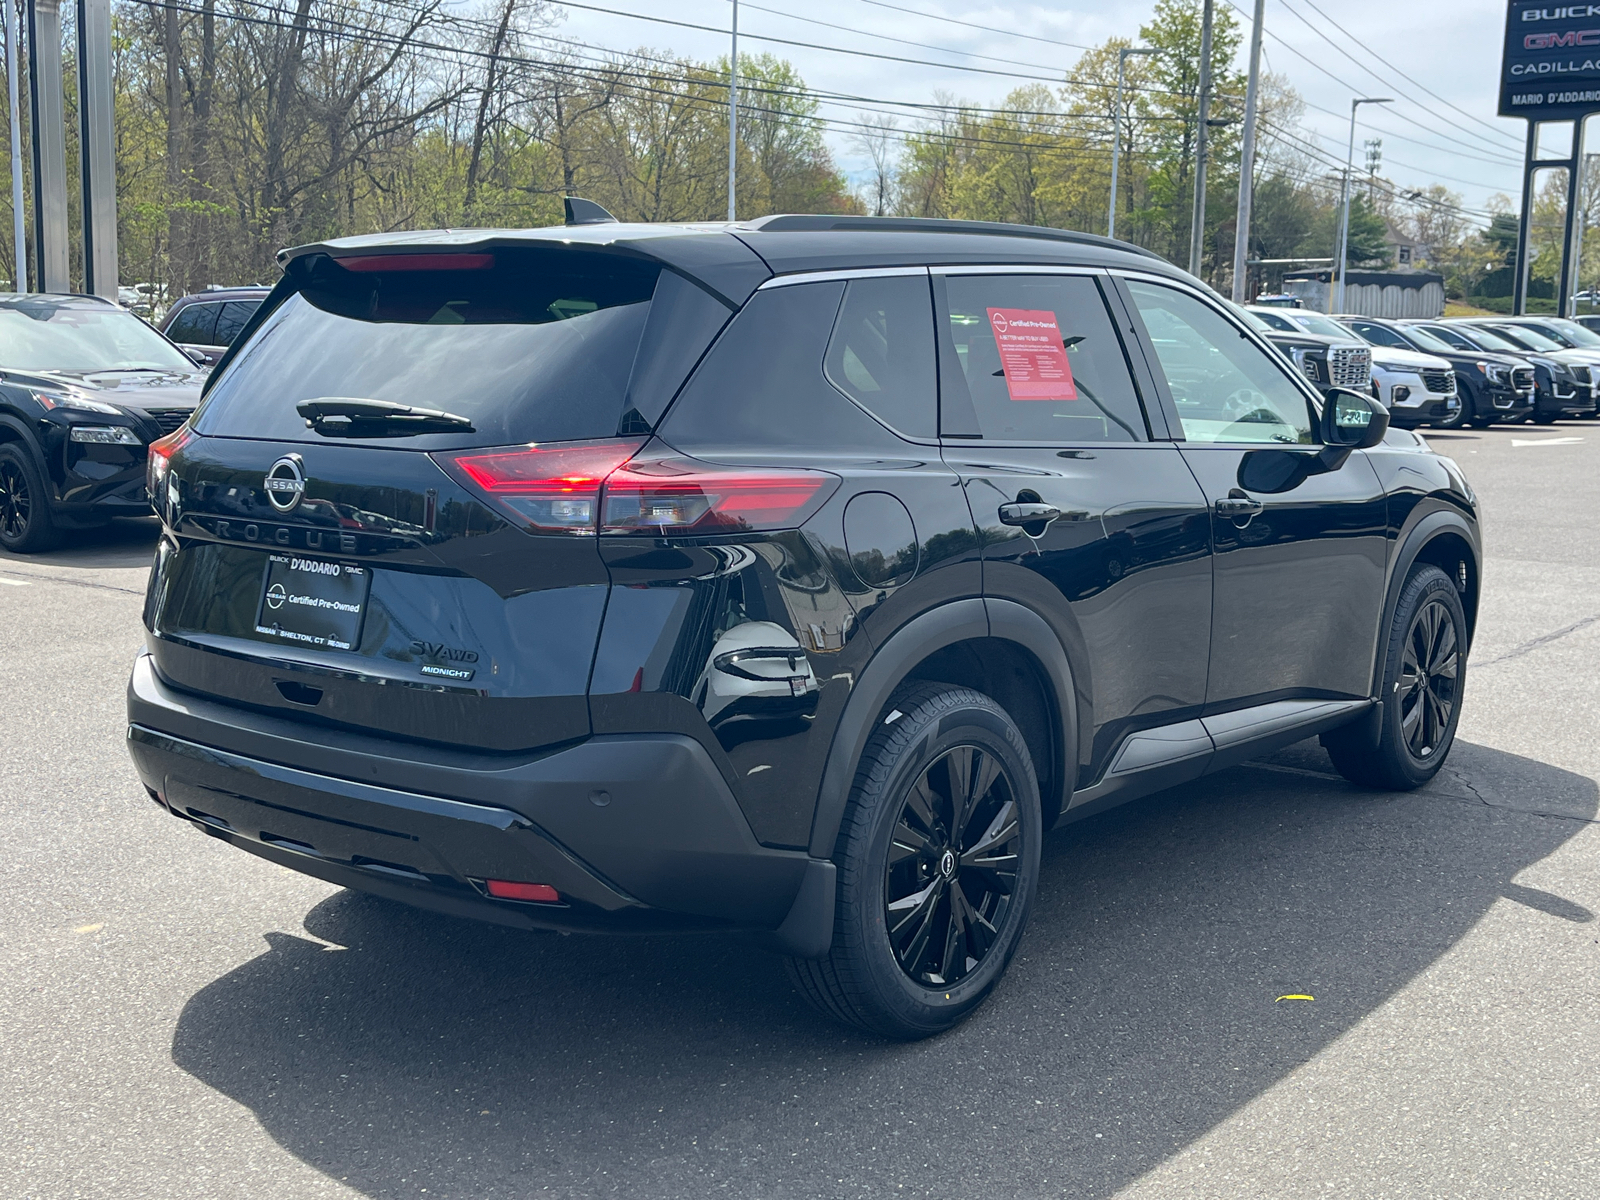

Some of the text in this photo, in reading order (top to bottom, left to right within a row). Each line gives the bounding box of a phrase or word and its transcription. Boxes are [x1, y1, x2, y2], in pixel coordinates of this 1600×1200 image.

[1522, 5, 1600, 21] BUICK
[1524, 30, 1600, 49] GMC
[1512, 91, 1600, 105] MARIO D'ADDARIO
[264, 479, 303, 491] NISSAN
[215, 520, 357, 551] ROGUE
[269, 555, 363, 576] BUICK D'ADDARIO GMC
[266, 592, 287, 600] NISSAN
[288, 594, 360, 613] Certified Pre-Owned
[256, 625, 276, 635] NISSAN
[280, 630, 313, 643] SHELTON,
[314, 636, 324, 644] CT
[440, 648, 479, 663] AWD
[421, 666, 470, 678] MIDNIGHT
